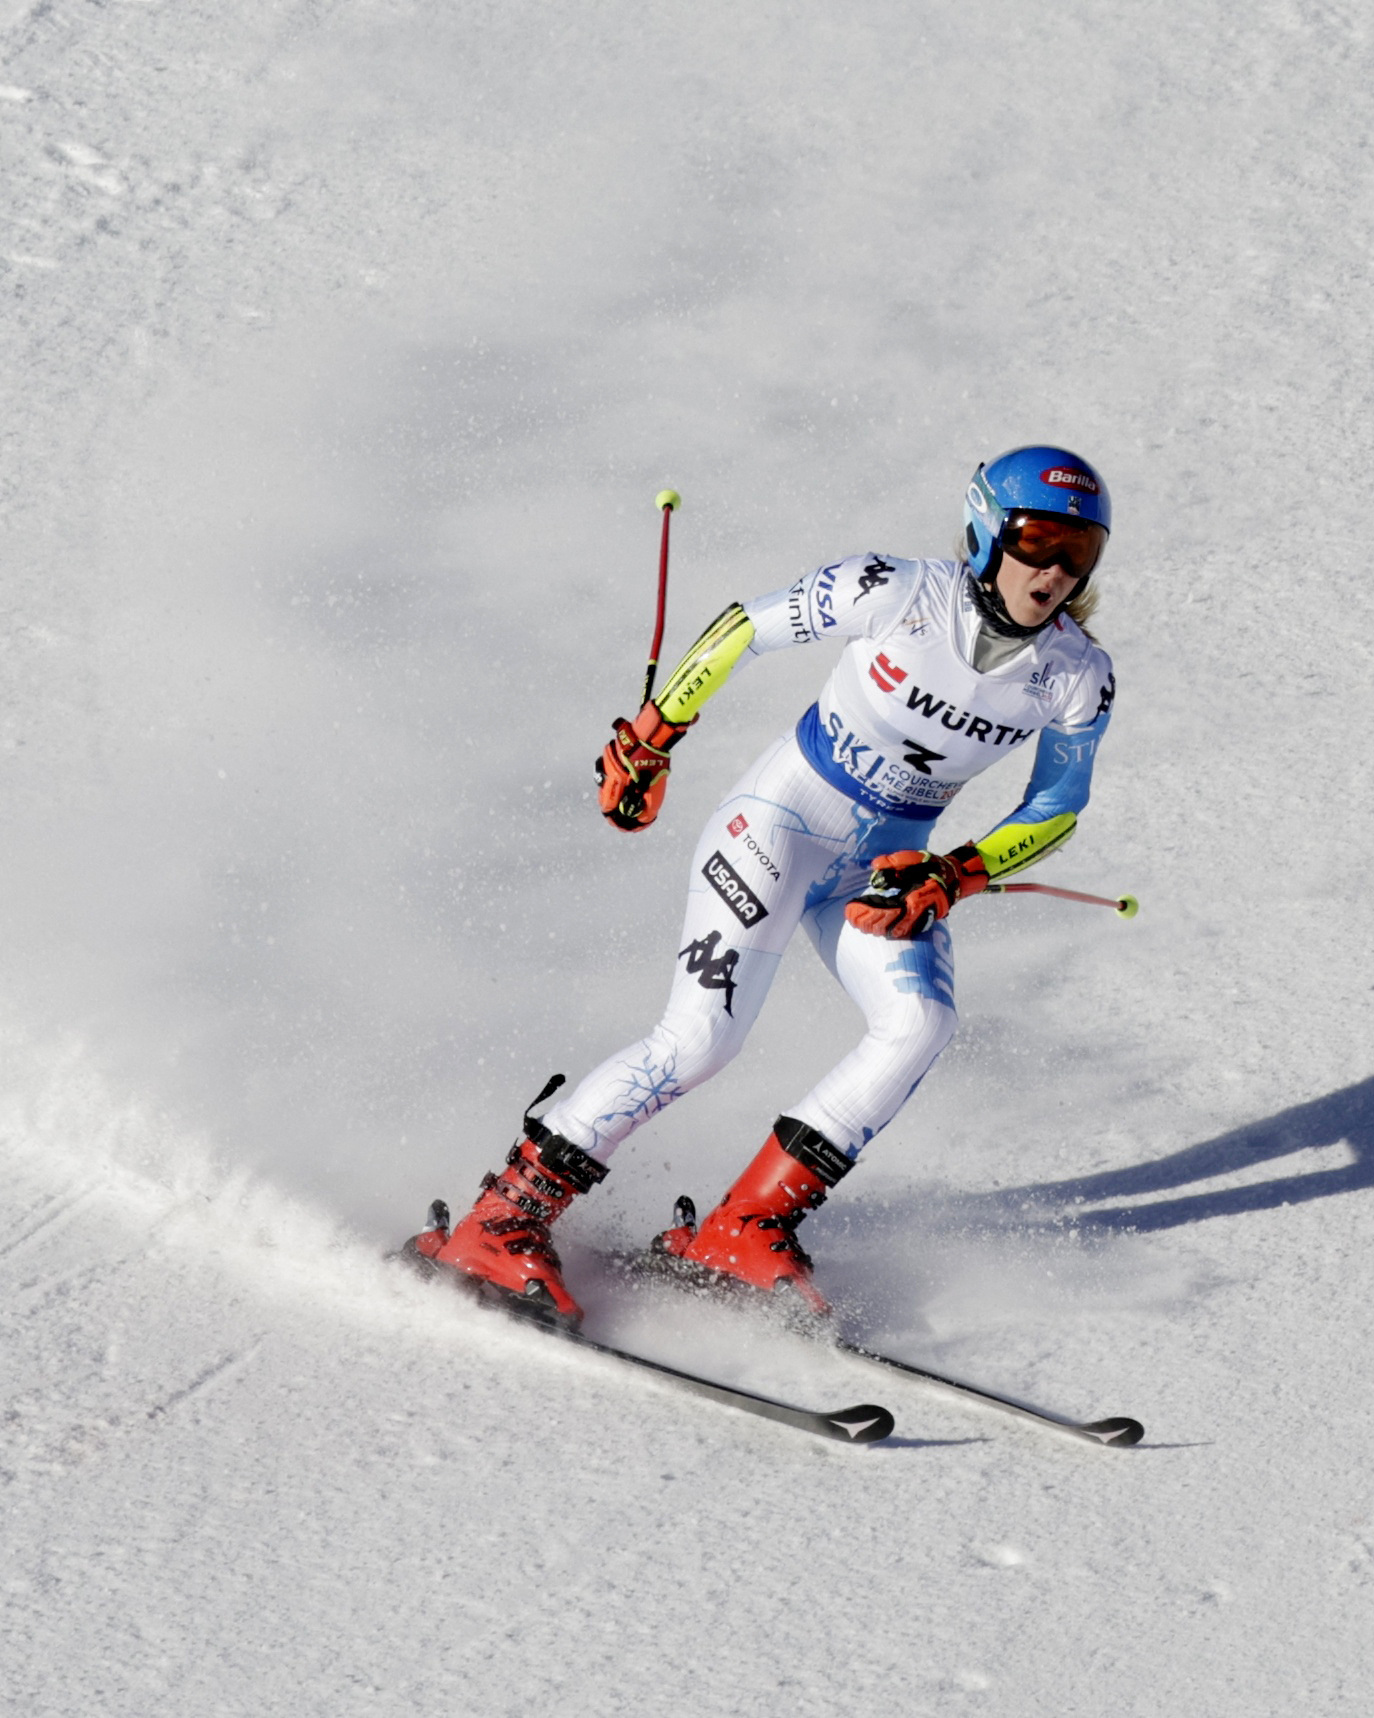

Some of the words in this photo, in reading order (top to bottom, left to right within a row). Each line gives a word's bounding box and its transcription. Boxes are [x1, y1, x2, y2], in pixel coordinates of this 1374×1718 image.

[1048, 469, 1097, 492] Barilla
[816, 561, 844, 629] VISA
[678, 666, 712, 706] LEKI
[905, 686, 1035, 747] WÜRTH
[633, 759, 664, 767] LEKI
[1053, 738, 1098, 765] STI
[743, 833, 780, 882] TOYOTA
[999, 834, 1036, 865] LEKI
[706, 857, 759, 921] USANA
[822, 1149, 847, 1170] ATOMIC
